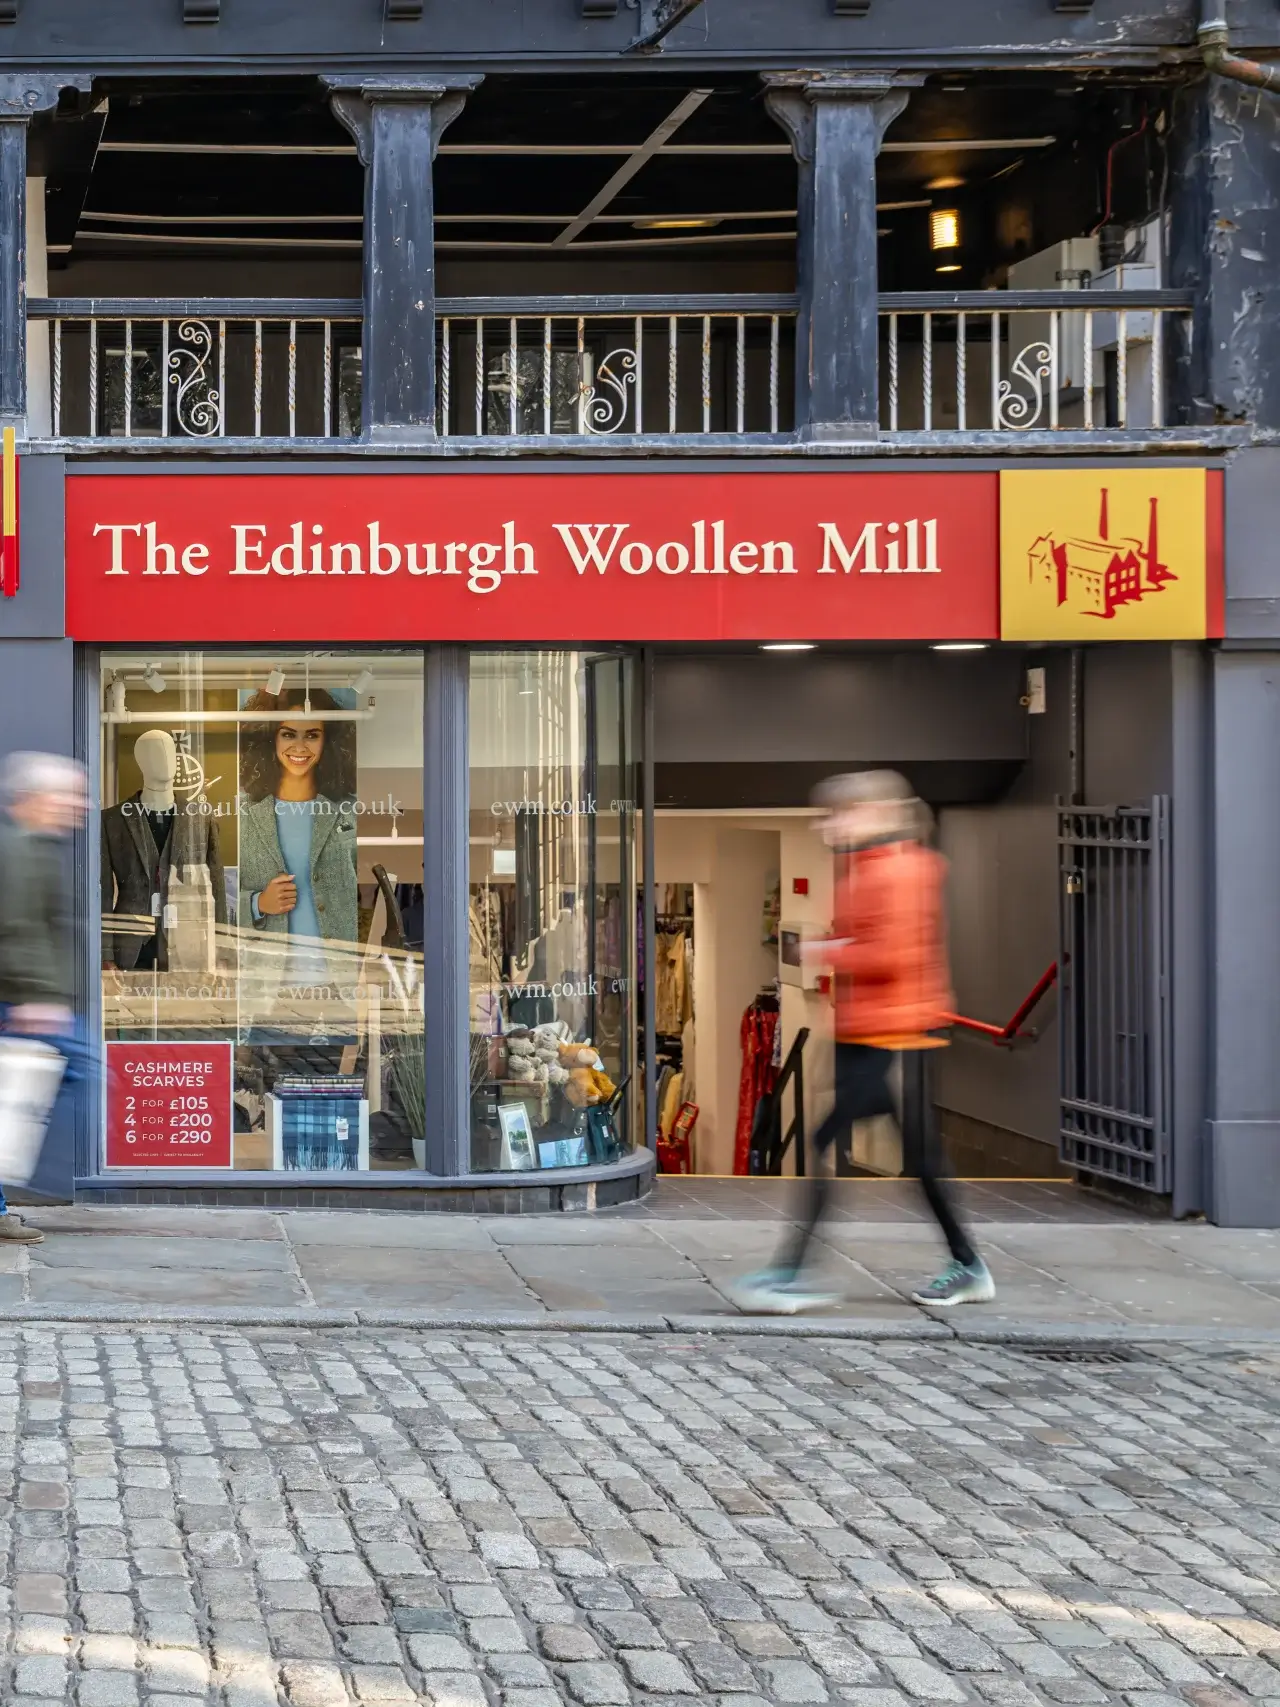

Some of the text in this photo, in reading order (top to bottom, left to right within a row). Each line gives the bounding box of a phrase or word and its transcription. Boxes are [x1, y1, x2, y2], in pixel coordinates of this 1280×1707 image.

[92, 518, 942, 594] The Edinburgh Woollen Mill
[274, 793, 404, 817] ewm.co.uk
[490, 793, 598, 816] ewm.co.uk
[121, 980, 246, 1000] ewm.co.u
[491, 974, 599, 999] ewm.co.uk
[124, 1062, 213, 1074] CASHMERE
[133, 1075, 205, 1087] SCARVES
[125, 1096, 209, 1110] 2 FOR £105
[124, 1113, 213, 1127] 4 FOR £200
[125, 1130, 212, 1144] 6 FOR £290
